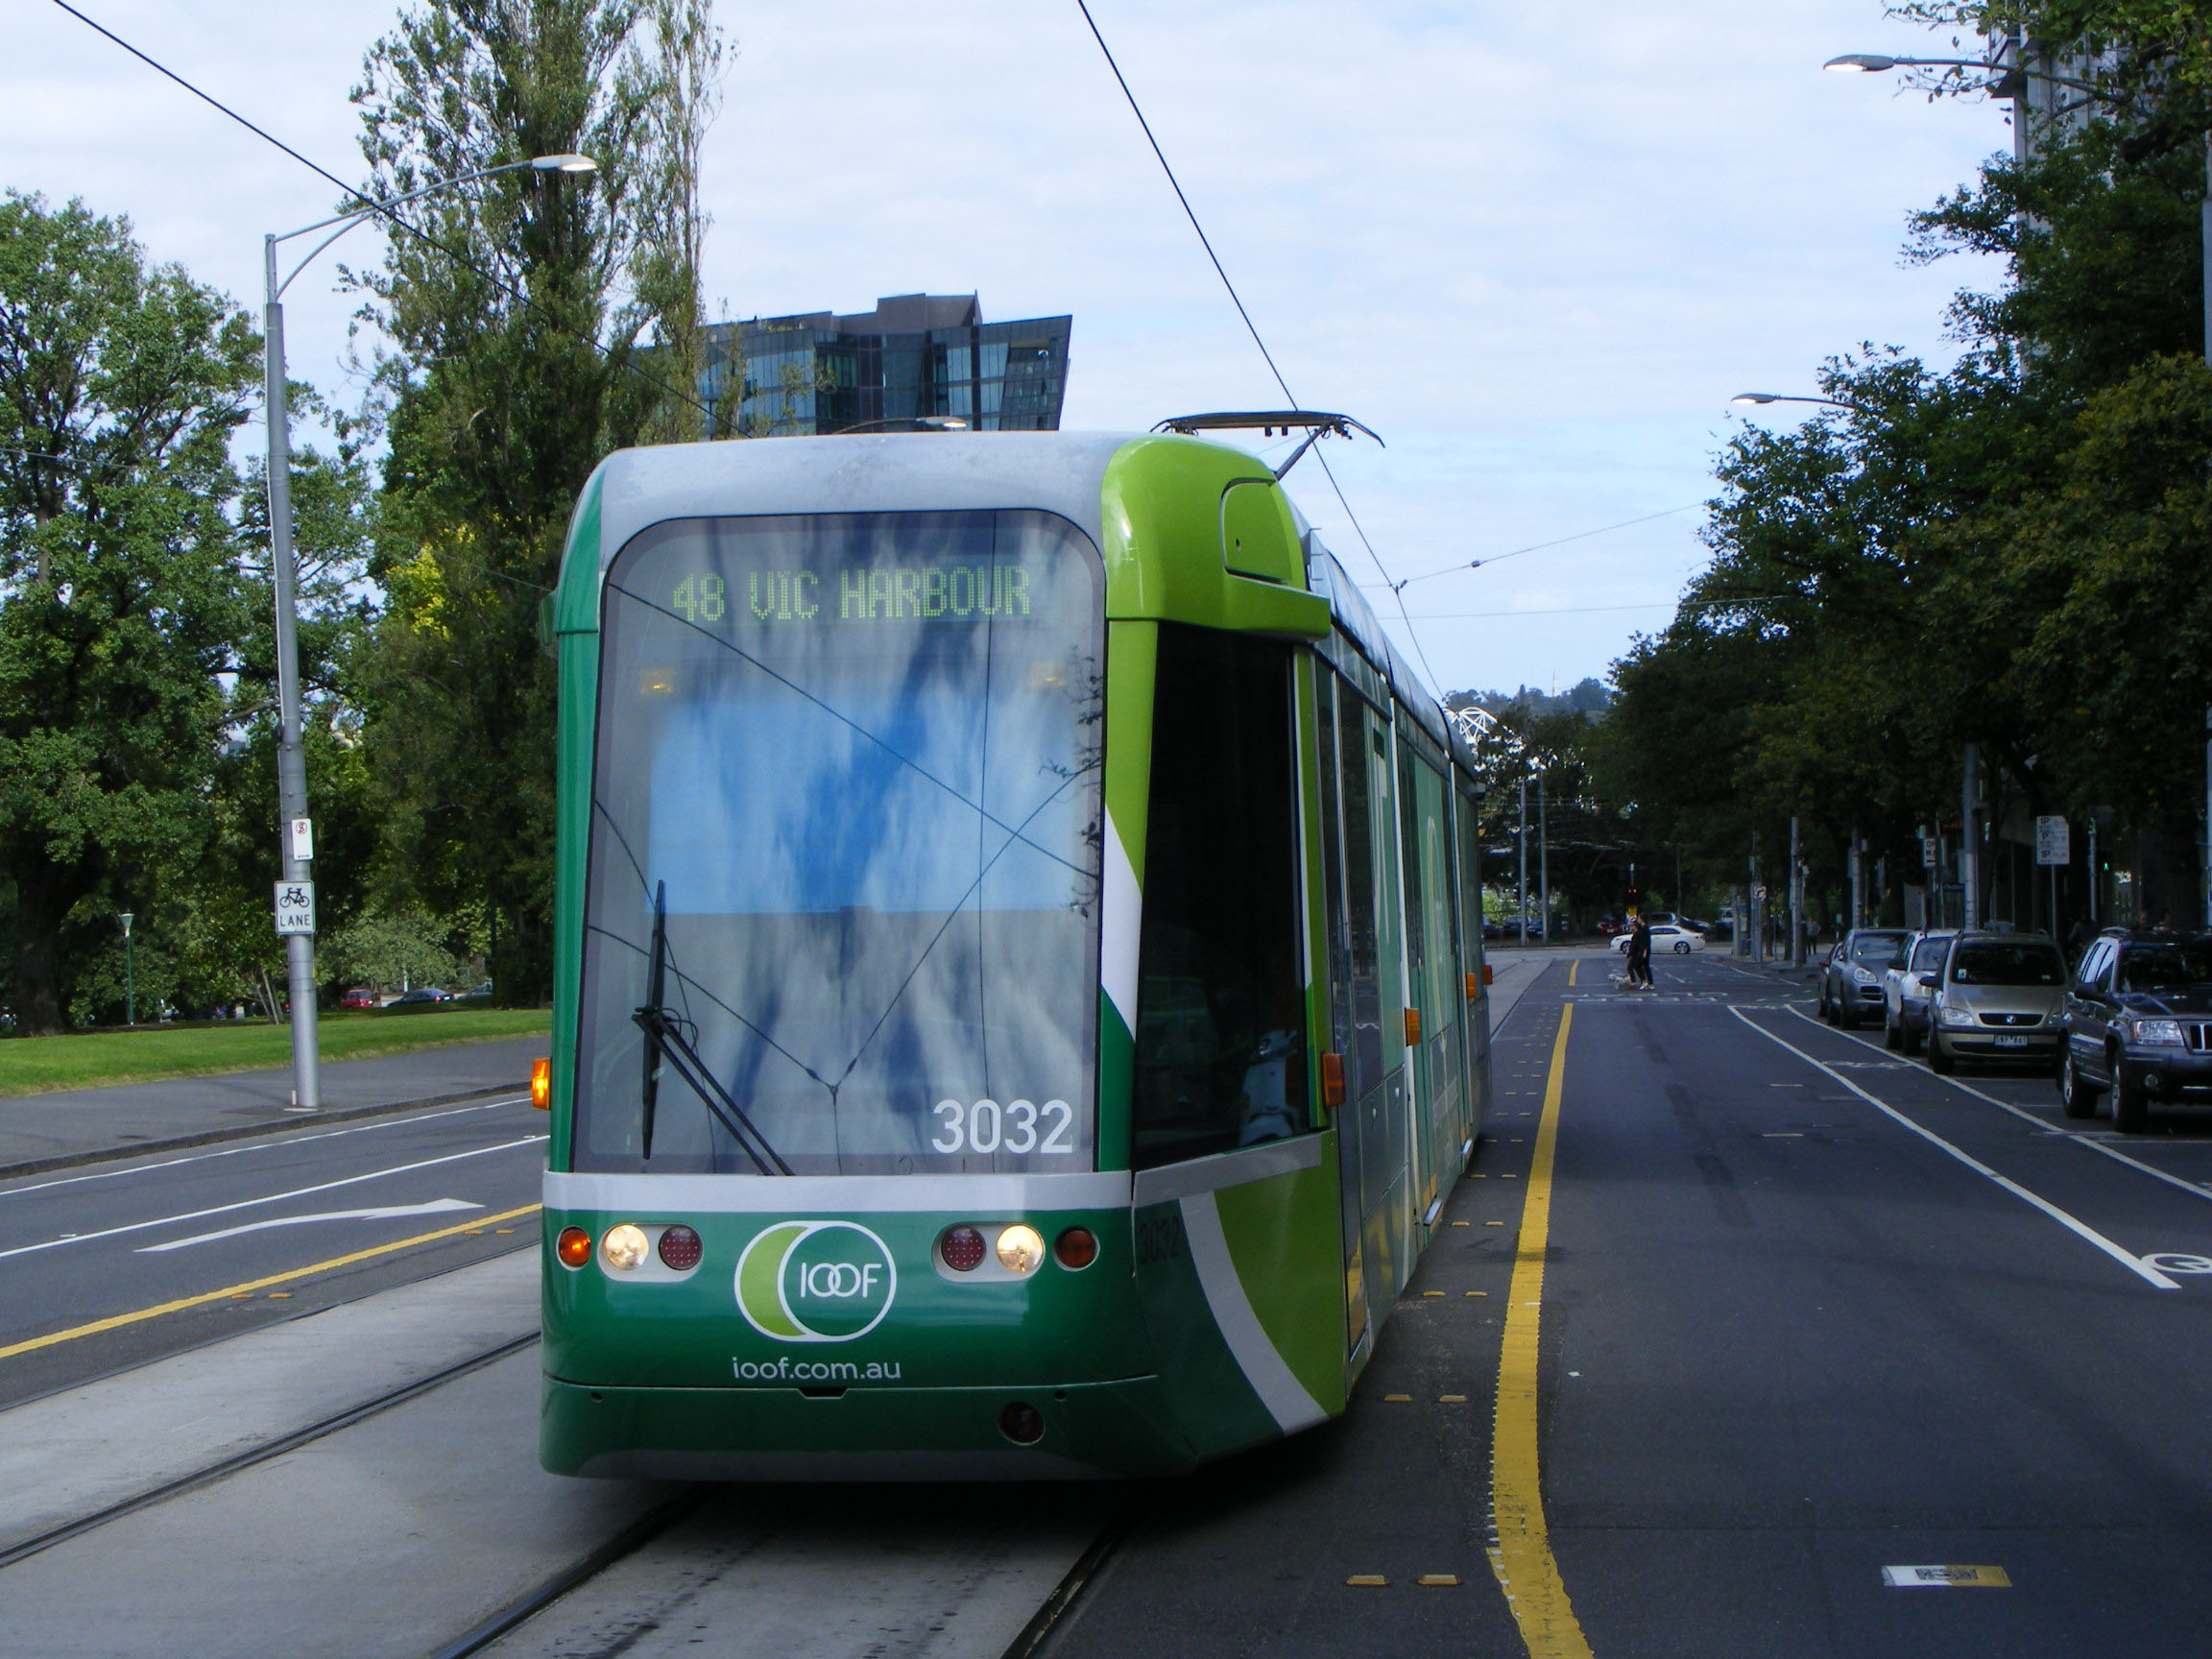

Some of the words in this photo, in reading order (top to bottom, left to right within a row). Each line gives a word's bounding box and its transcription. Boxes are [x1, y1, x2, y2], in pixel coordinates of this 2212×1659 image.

[673, 573, 725, 622] 48
[750, 570, 819, 619] VIC
[841, 565, 1030, 618] HARBOUR
[279, 914, 311, 926] LANE
[931, 1098, 1073, 1154] 3032
[800, 1262, 882, 1299] IOOF
[733, 1356, 902, 1380] ioof.com.au
